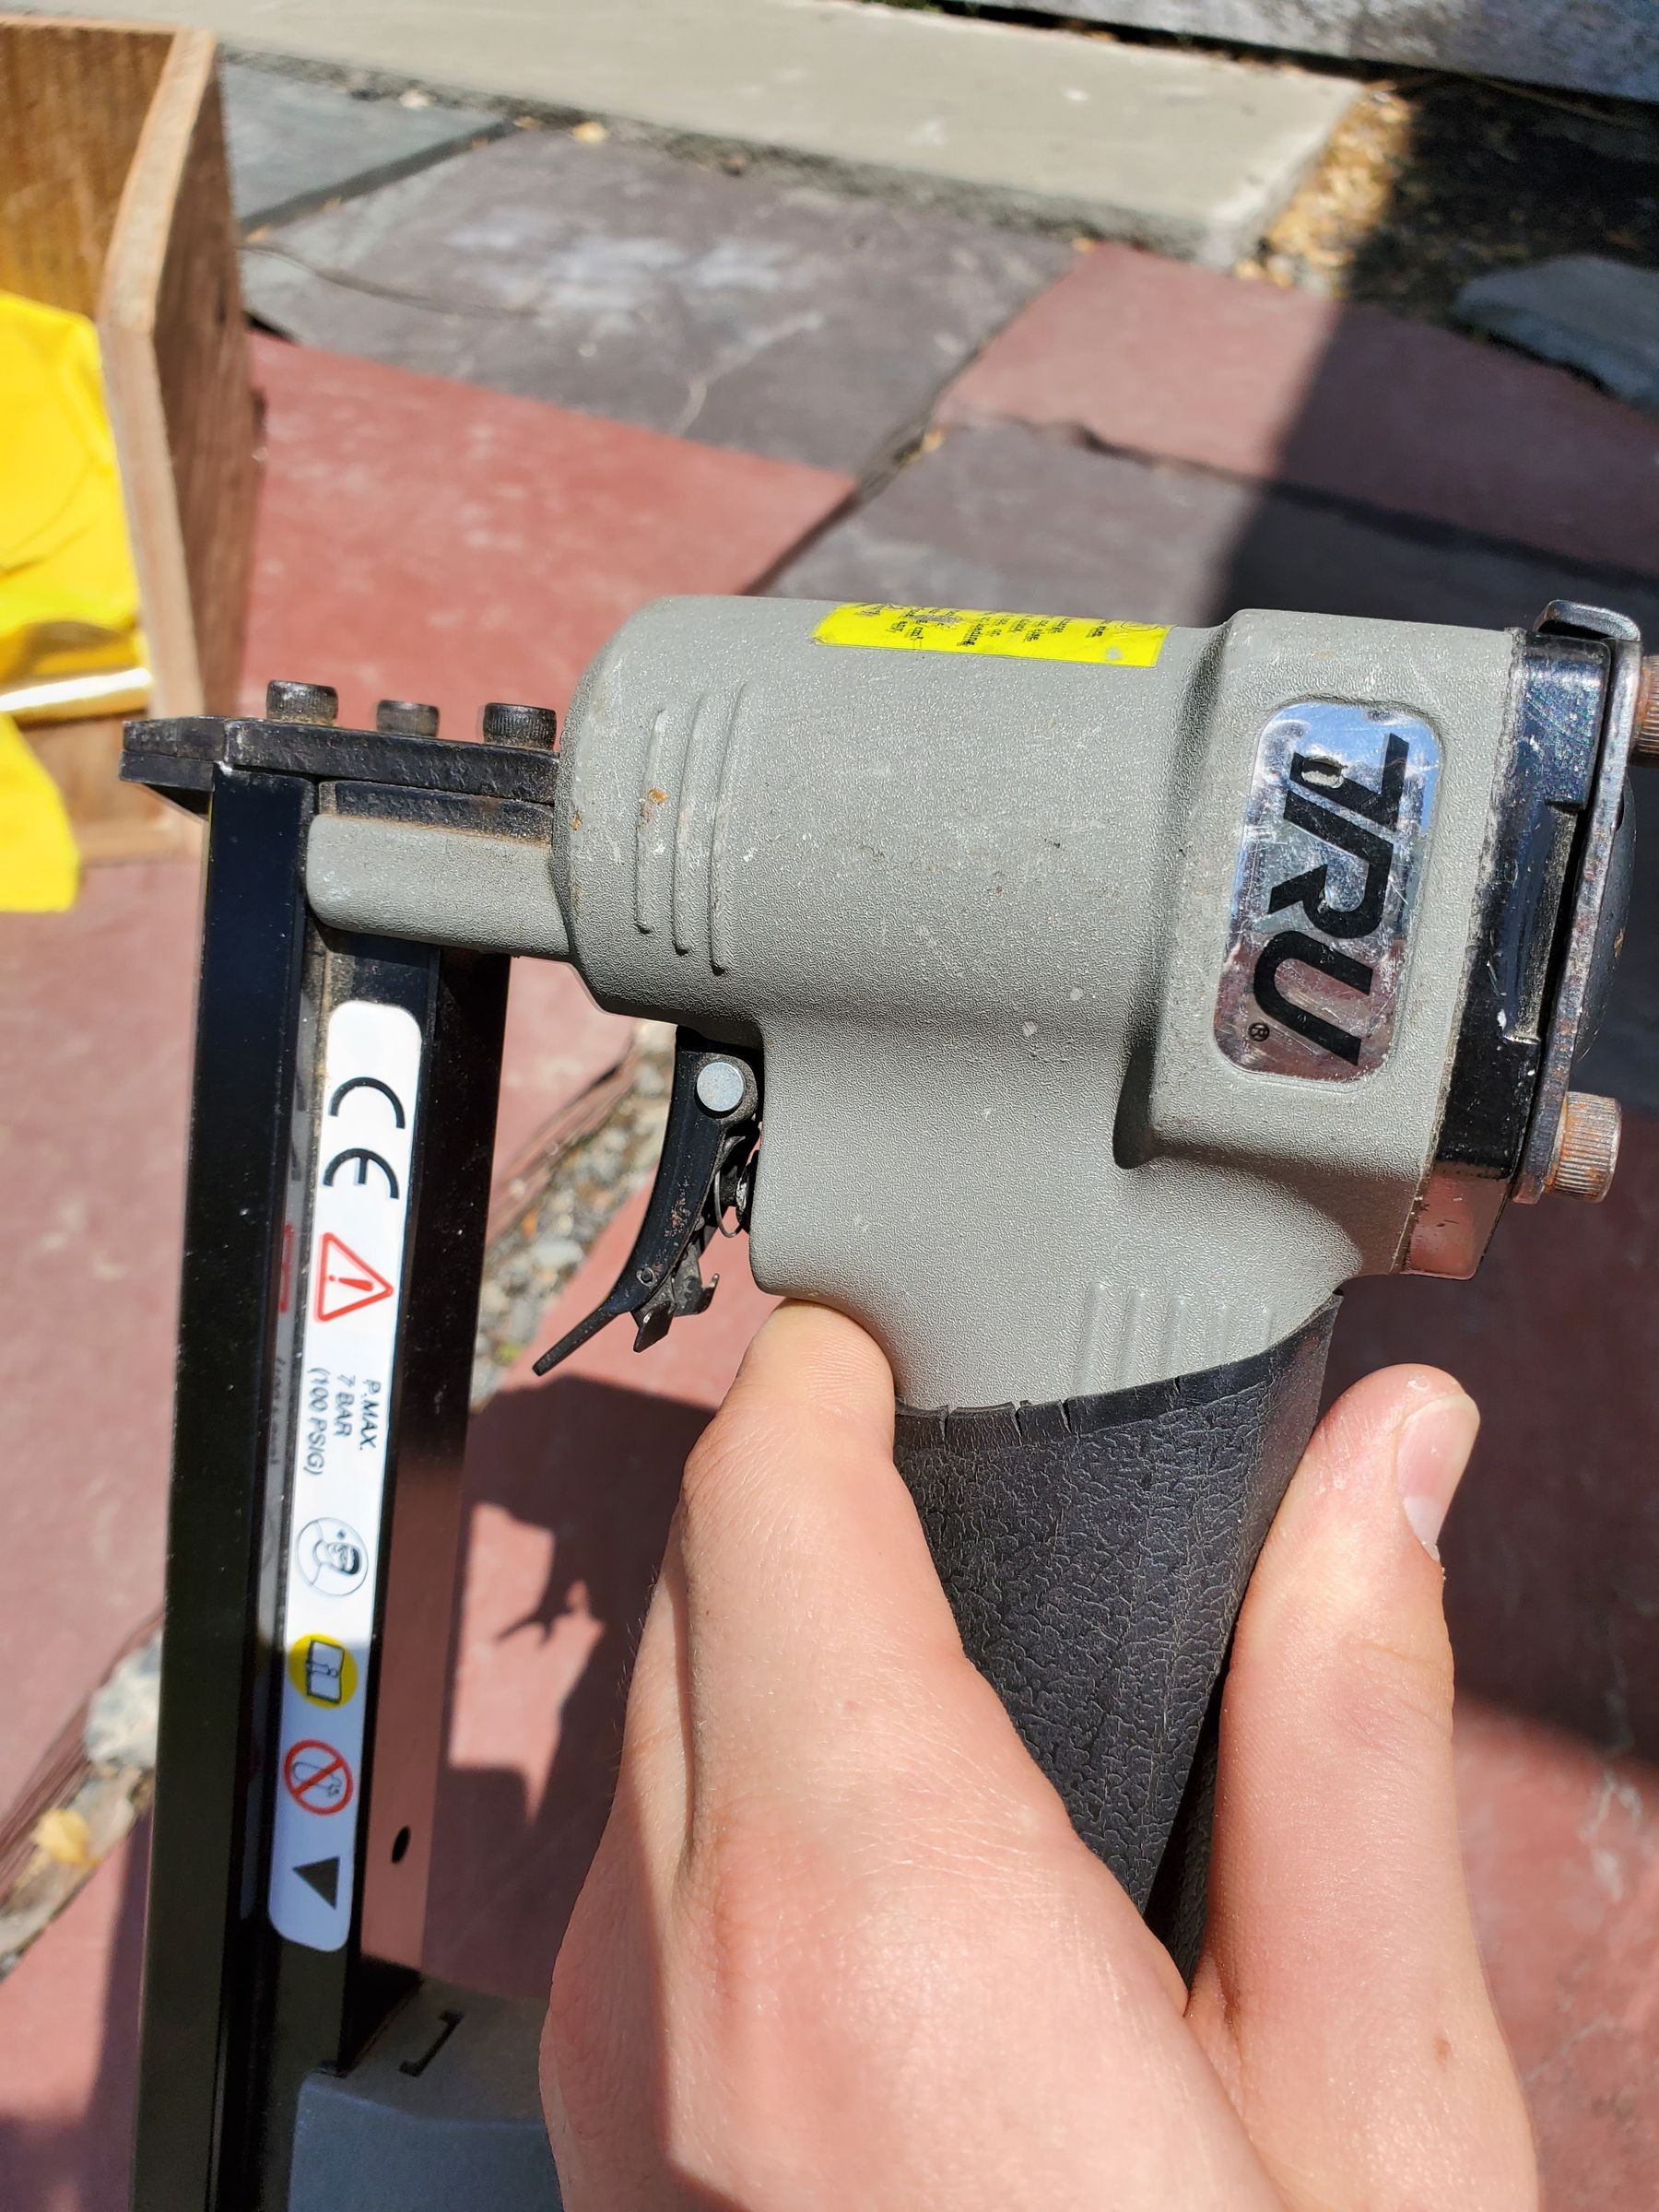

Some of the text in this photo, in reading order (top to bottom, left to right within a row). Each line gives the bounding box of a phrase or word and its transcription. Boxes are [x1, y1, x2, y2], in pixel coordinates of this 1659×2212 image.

[323, 1077, 406, 1199] CE
[303, 1368, 330, 1475] (100 PSIG)
[334, 1374, 356, 1436] 7 BAR
